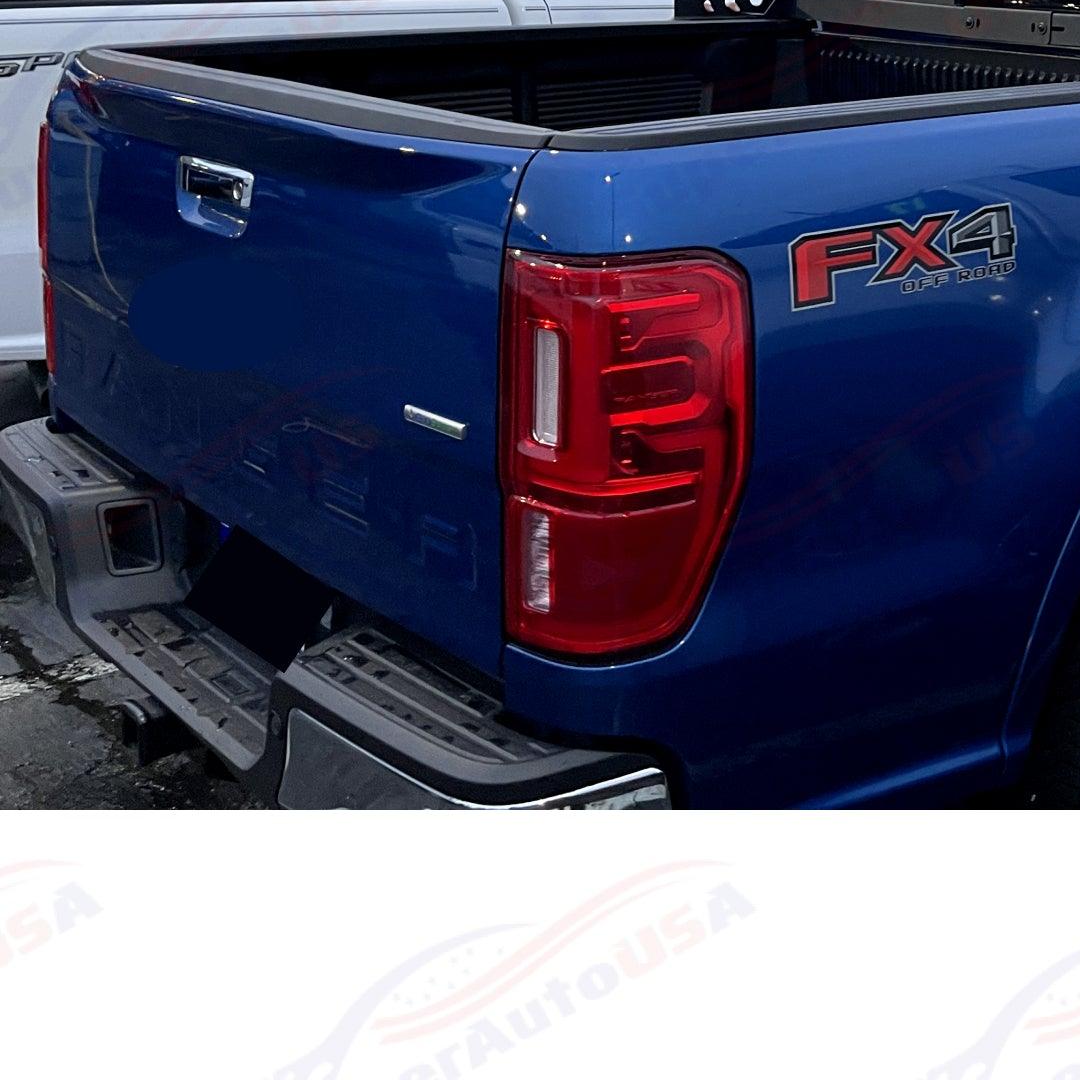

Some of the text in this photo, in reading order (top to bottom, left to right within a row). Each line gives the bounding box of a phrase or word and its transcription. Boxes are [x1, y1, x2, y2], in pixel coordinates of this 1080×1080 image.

[788, 202, 1018, 312] FX4
[900, 260, 1017, 295] OFF ROAD
